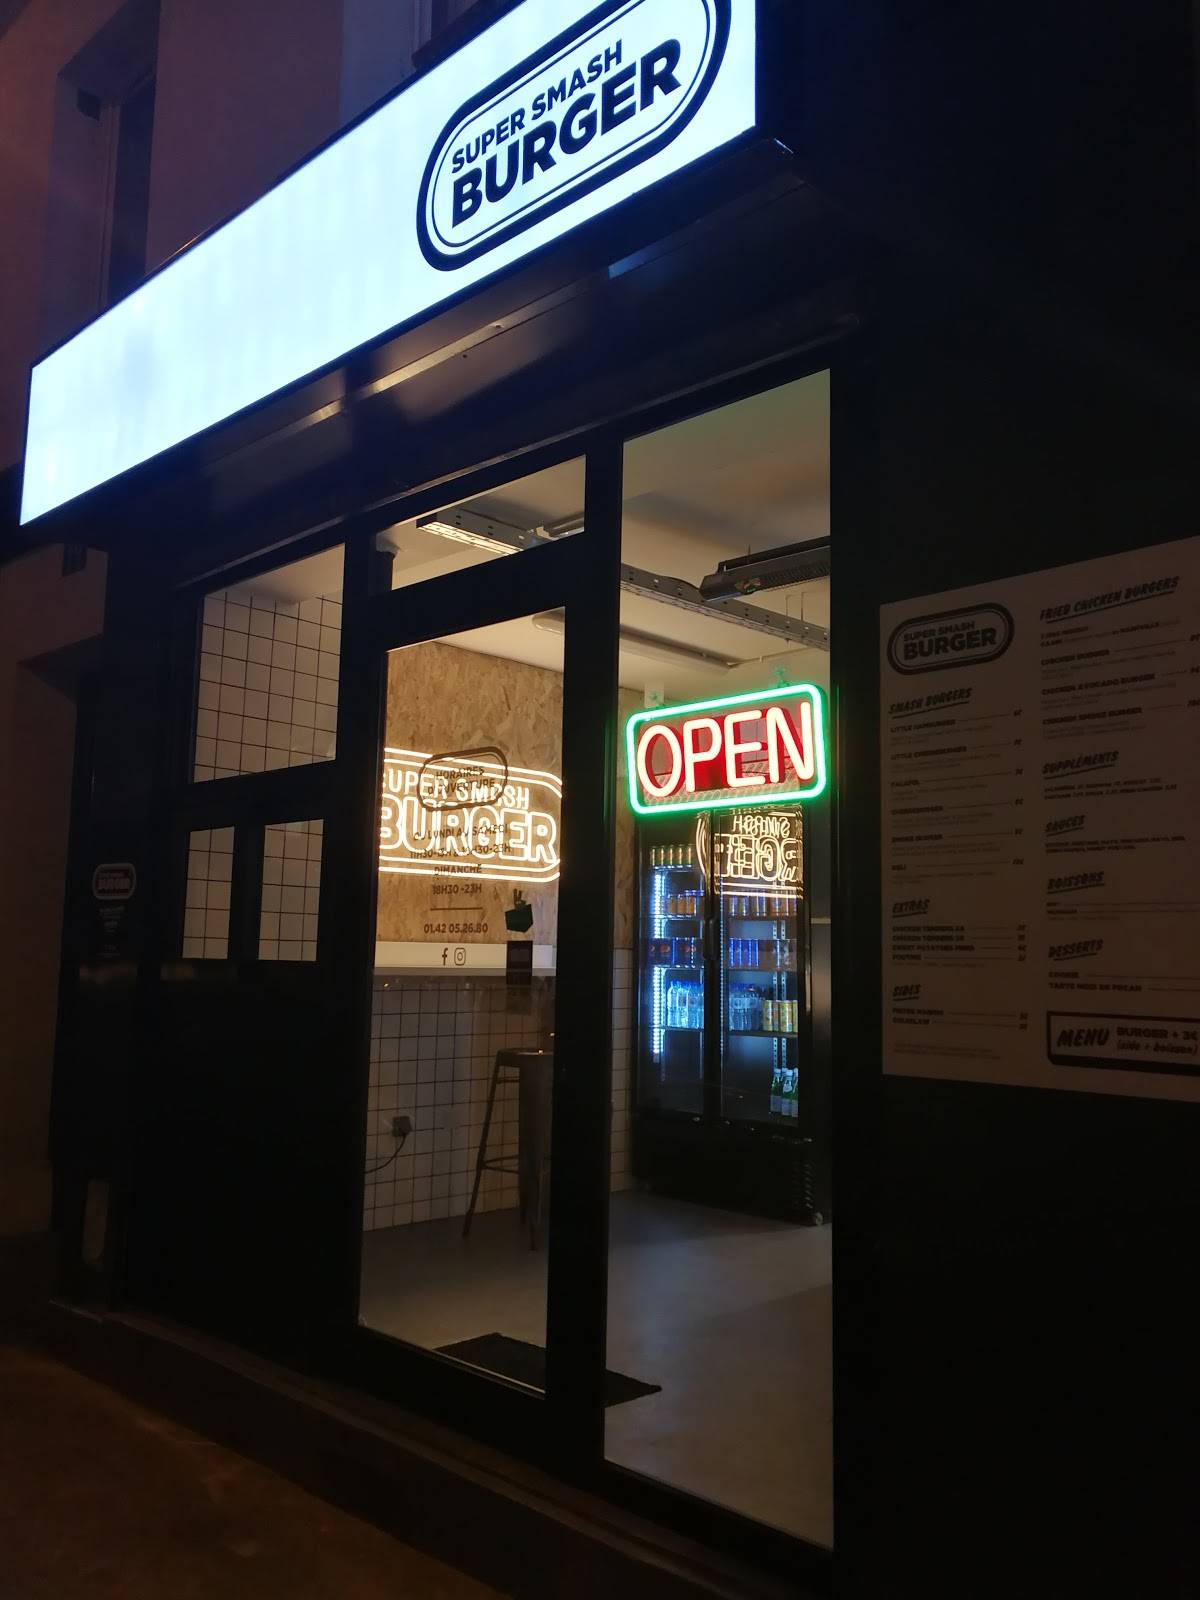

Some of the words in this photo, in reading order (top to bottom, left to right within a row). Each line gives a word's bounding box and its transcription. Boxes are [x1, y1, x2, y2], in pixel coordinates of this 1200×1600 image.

[452, 108, 526, 173] SUPER
[531, 38, 622, 120] SMASH
[452, 38, 682, 228] BURGER
[1040, 603, 1071, 621] FRIED
[1074, 590, 1122, 612] CHICKEN
[1124, 575, 1180, 600] BURGERS
[903, 629, 936, 642] SUPER
[938, 620, 976, 636] SMASH
[903, 627, 997, 661] BURGER
[889, 698, 924, 714] SMASH
[925, 687, 973, 707] BURGERS
[637, 701, 815, 797] OPEN
[1042, 750, 1119, 774] SUPPLÉMENTS
[380, 794, 558, 863] BURGER
[1045, 814, 1086, 833] SAUCES
[434, 864, 483, 876] DIMANCHE
[1047, 870, 1105, 890] BOISSONS
[892, 898, 931, 914] EXTRAS
[1047, 938, 1104, 958] DESSERTS
[892, 984, 922, 997] SIDES
[1056, 1027, 1110, 1048] MENU
[1116, 1026, 1169, 1039] BURGER
